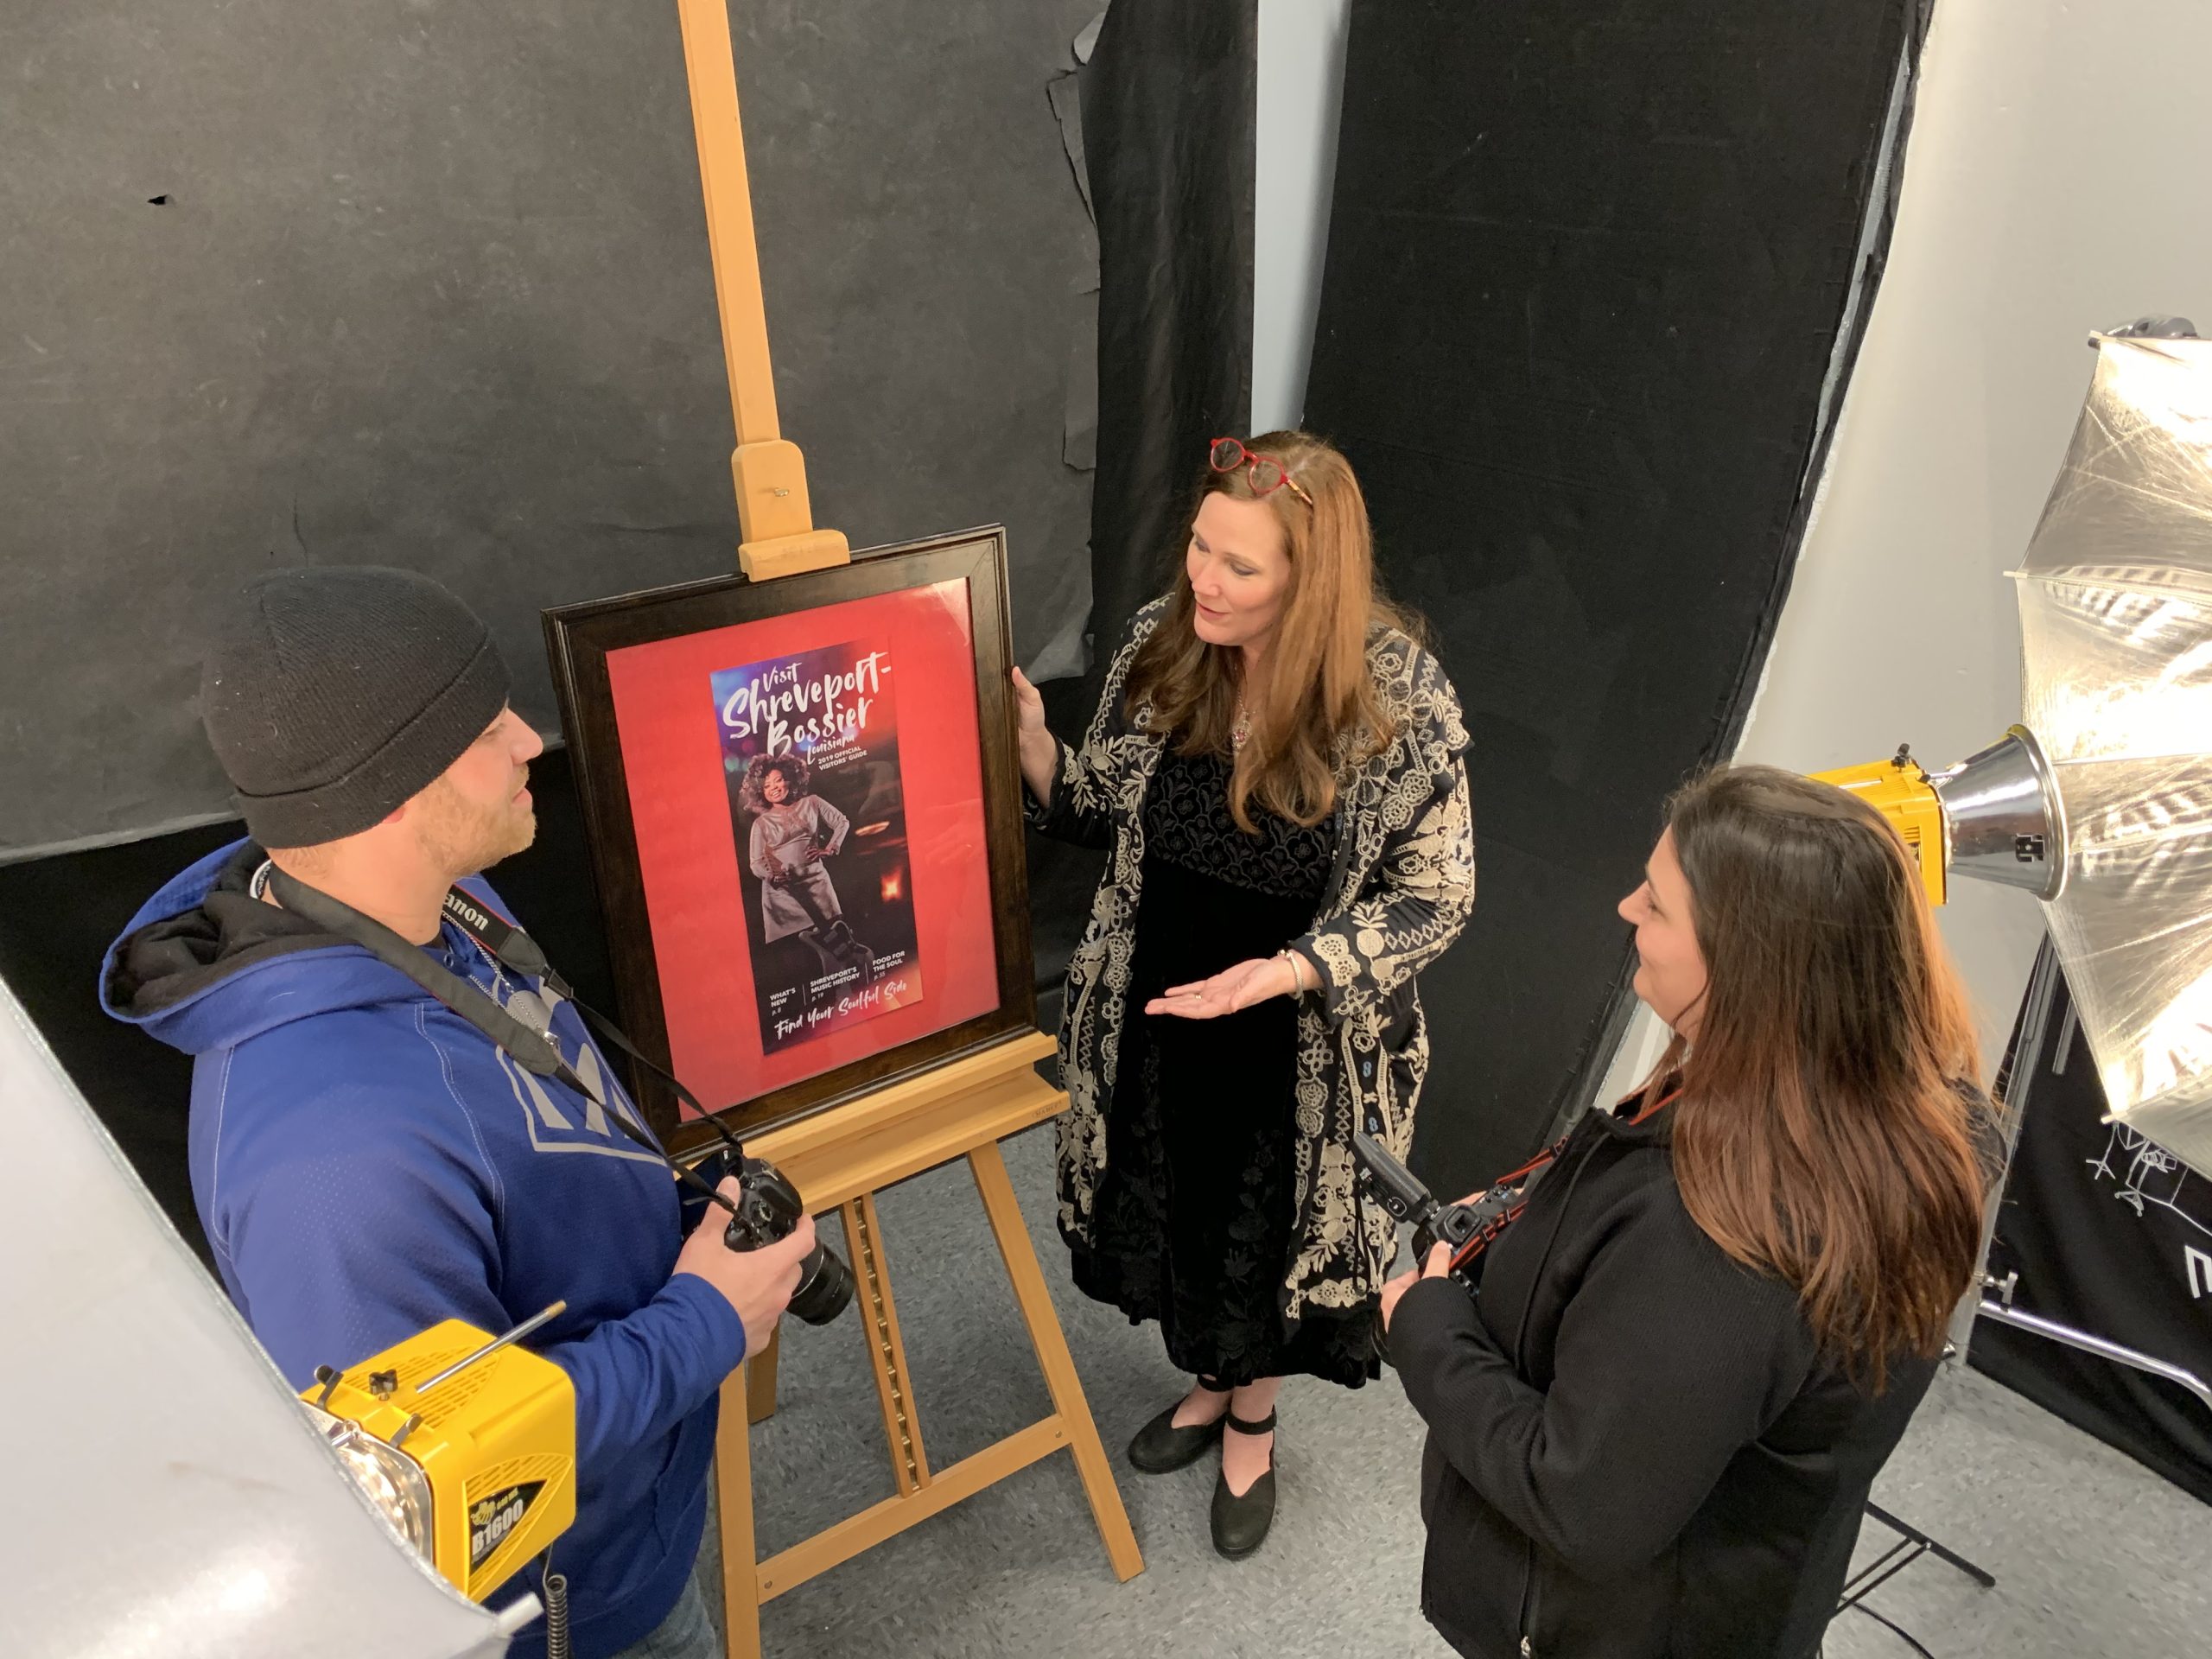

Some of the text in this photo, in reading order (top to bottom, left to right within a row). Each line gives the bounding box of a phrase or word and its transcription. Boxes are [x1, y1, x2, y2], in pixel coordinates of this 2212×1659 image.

[763, 662, 802, 691] Visit
[766, 697, 873, 757] Bossier
[818, 746, 862, 765] 2019 OFFICIAL
[849, 749, 868, 760] GUIDE
[444, 893, 488, 931] anon
[872, 950, 906, 966] FOOD FOR
[873, 958, 904, 973] THE SOUL
[810, 966, 857, 987] SHREVEPORT'S
[810, 972, 861, 994] MUSIC HISTORY
[770, 987, 796, 1001] WHAT'S
[771, 997, 788, 1008] NEW
[774, 980, 907, 1040] Find Your Soulful Side
[472, 1498, 524, 1556] B1600
